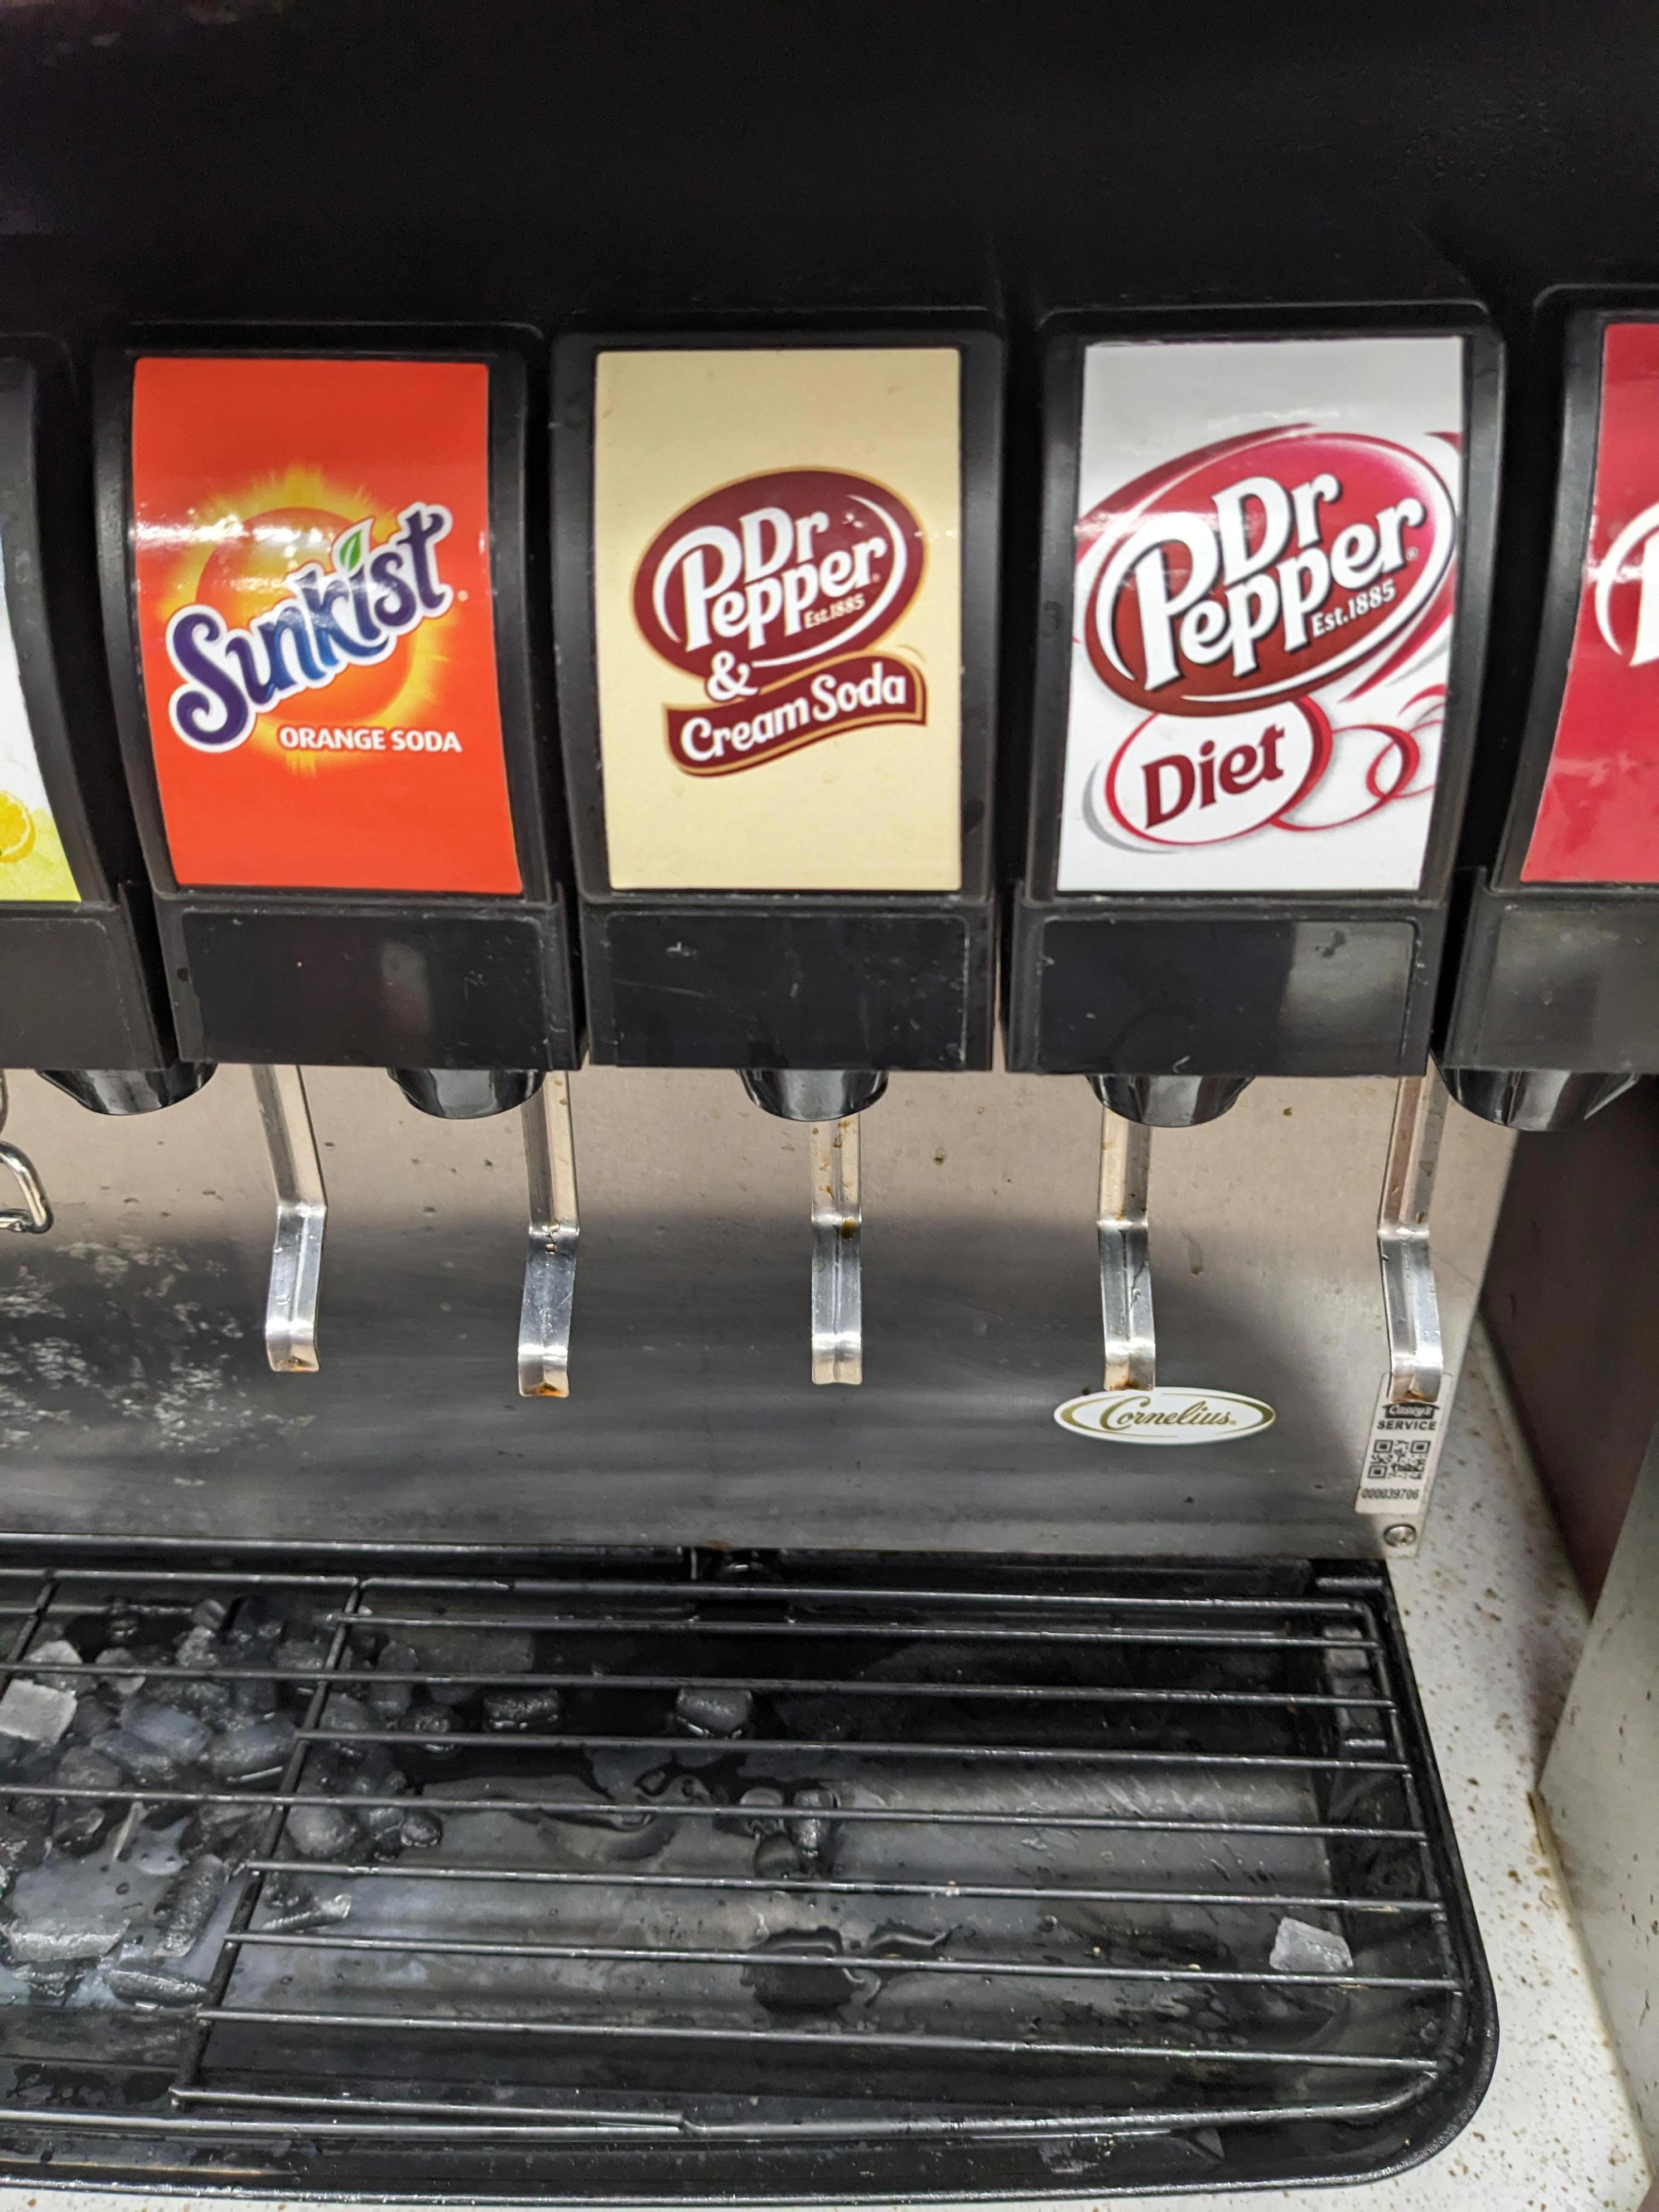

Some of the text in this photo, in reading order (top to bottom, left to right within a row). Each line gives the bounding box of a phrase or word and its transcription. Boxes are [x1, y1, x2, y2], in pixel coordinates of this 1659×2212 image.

[740, 507, 830, 585] Dr
[1212, 473, 1342, 586] Dr
[170, 505, 450, 750] Sunkist
[653, 526, 888, 653] Pepper
[1096, 498, 1426, 691] Pepper
[680, 662, 906, 761] Cream Soda
[707, 651, 759, 701] &
[279, 727, 462, 753] ORANGE SODA
[1141, 723, 1285, 829] Diet
[1099, 1395, 1231, 1432] Cornelius
[1377, 1420, 1436, 1431] SERVICE
